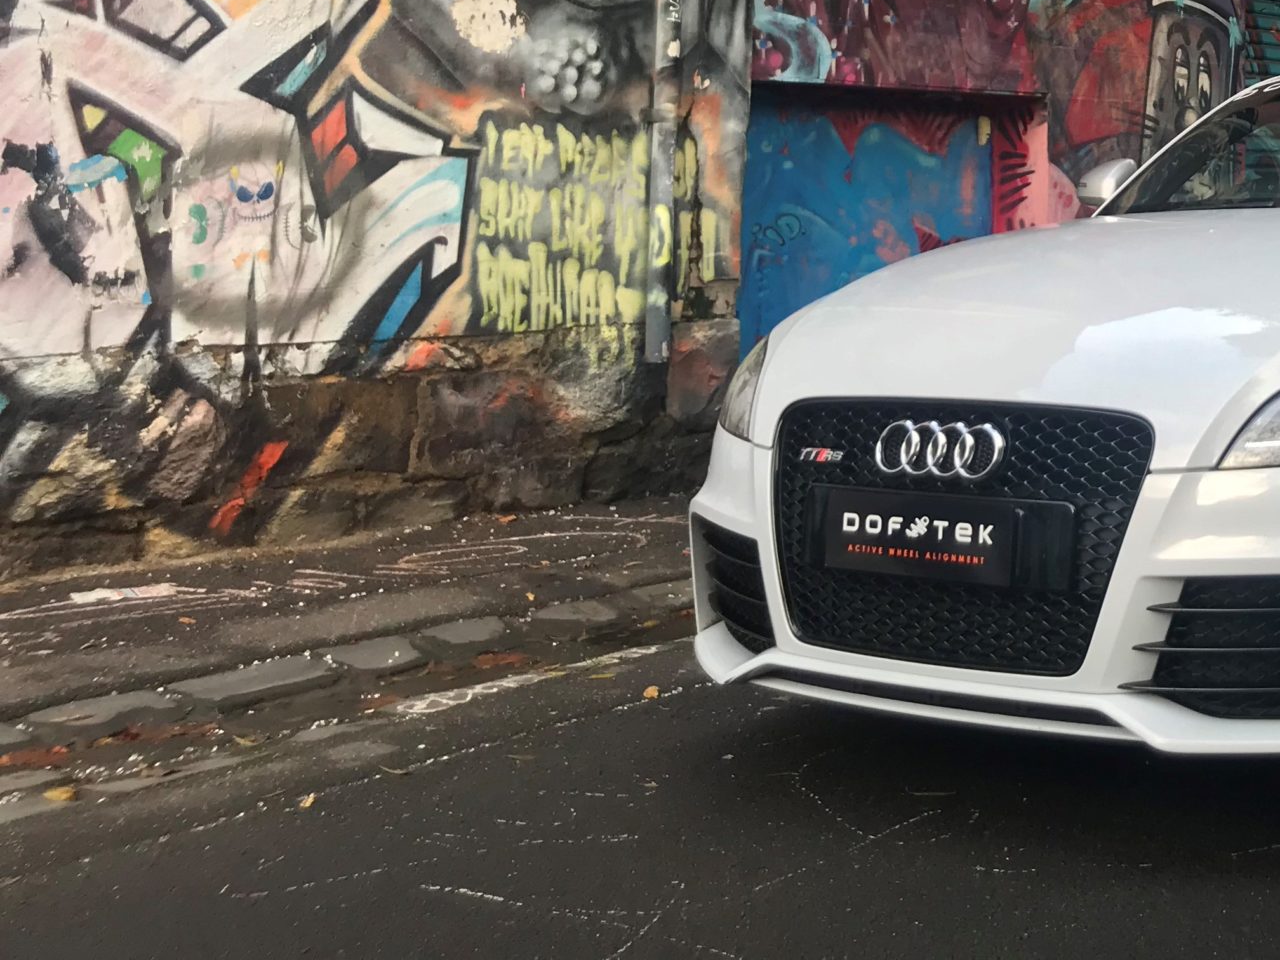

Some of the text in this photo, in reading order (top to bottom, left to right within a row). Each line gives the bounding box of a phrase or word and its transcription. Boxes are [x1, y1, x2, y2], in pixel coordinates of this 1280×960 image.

[847, 544, 986, 565] ACTIVE WHEEL ALIGNMENT
